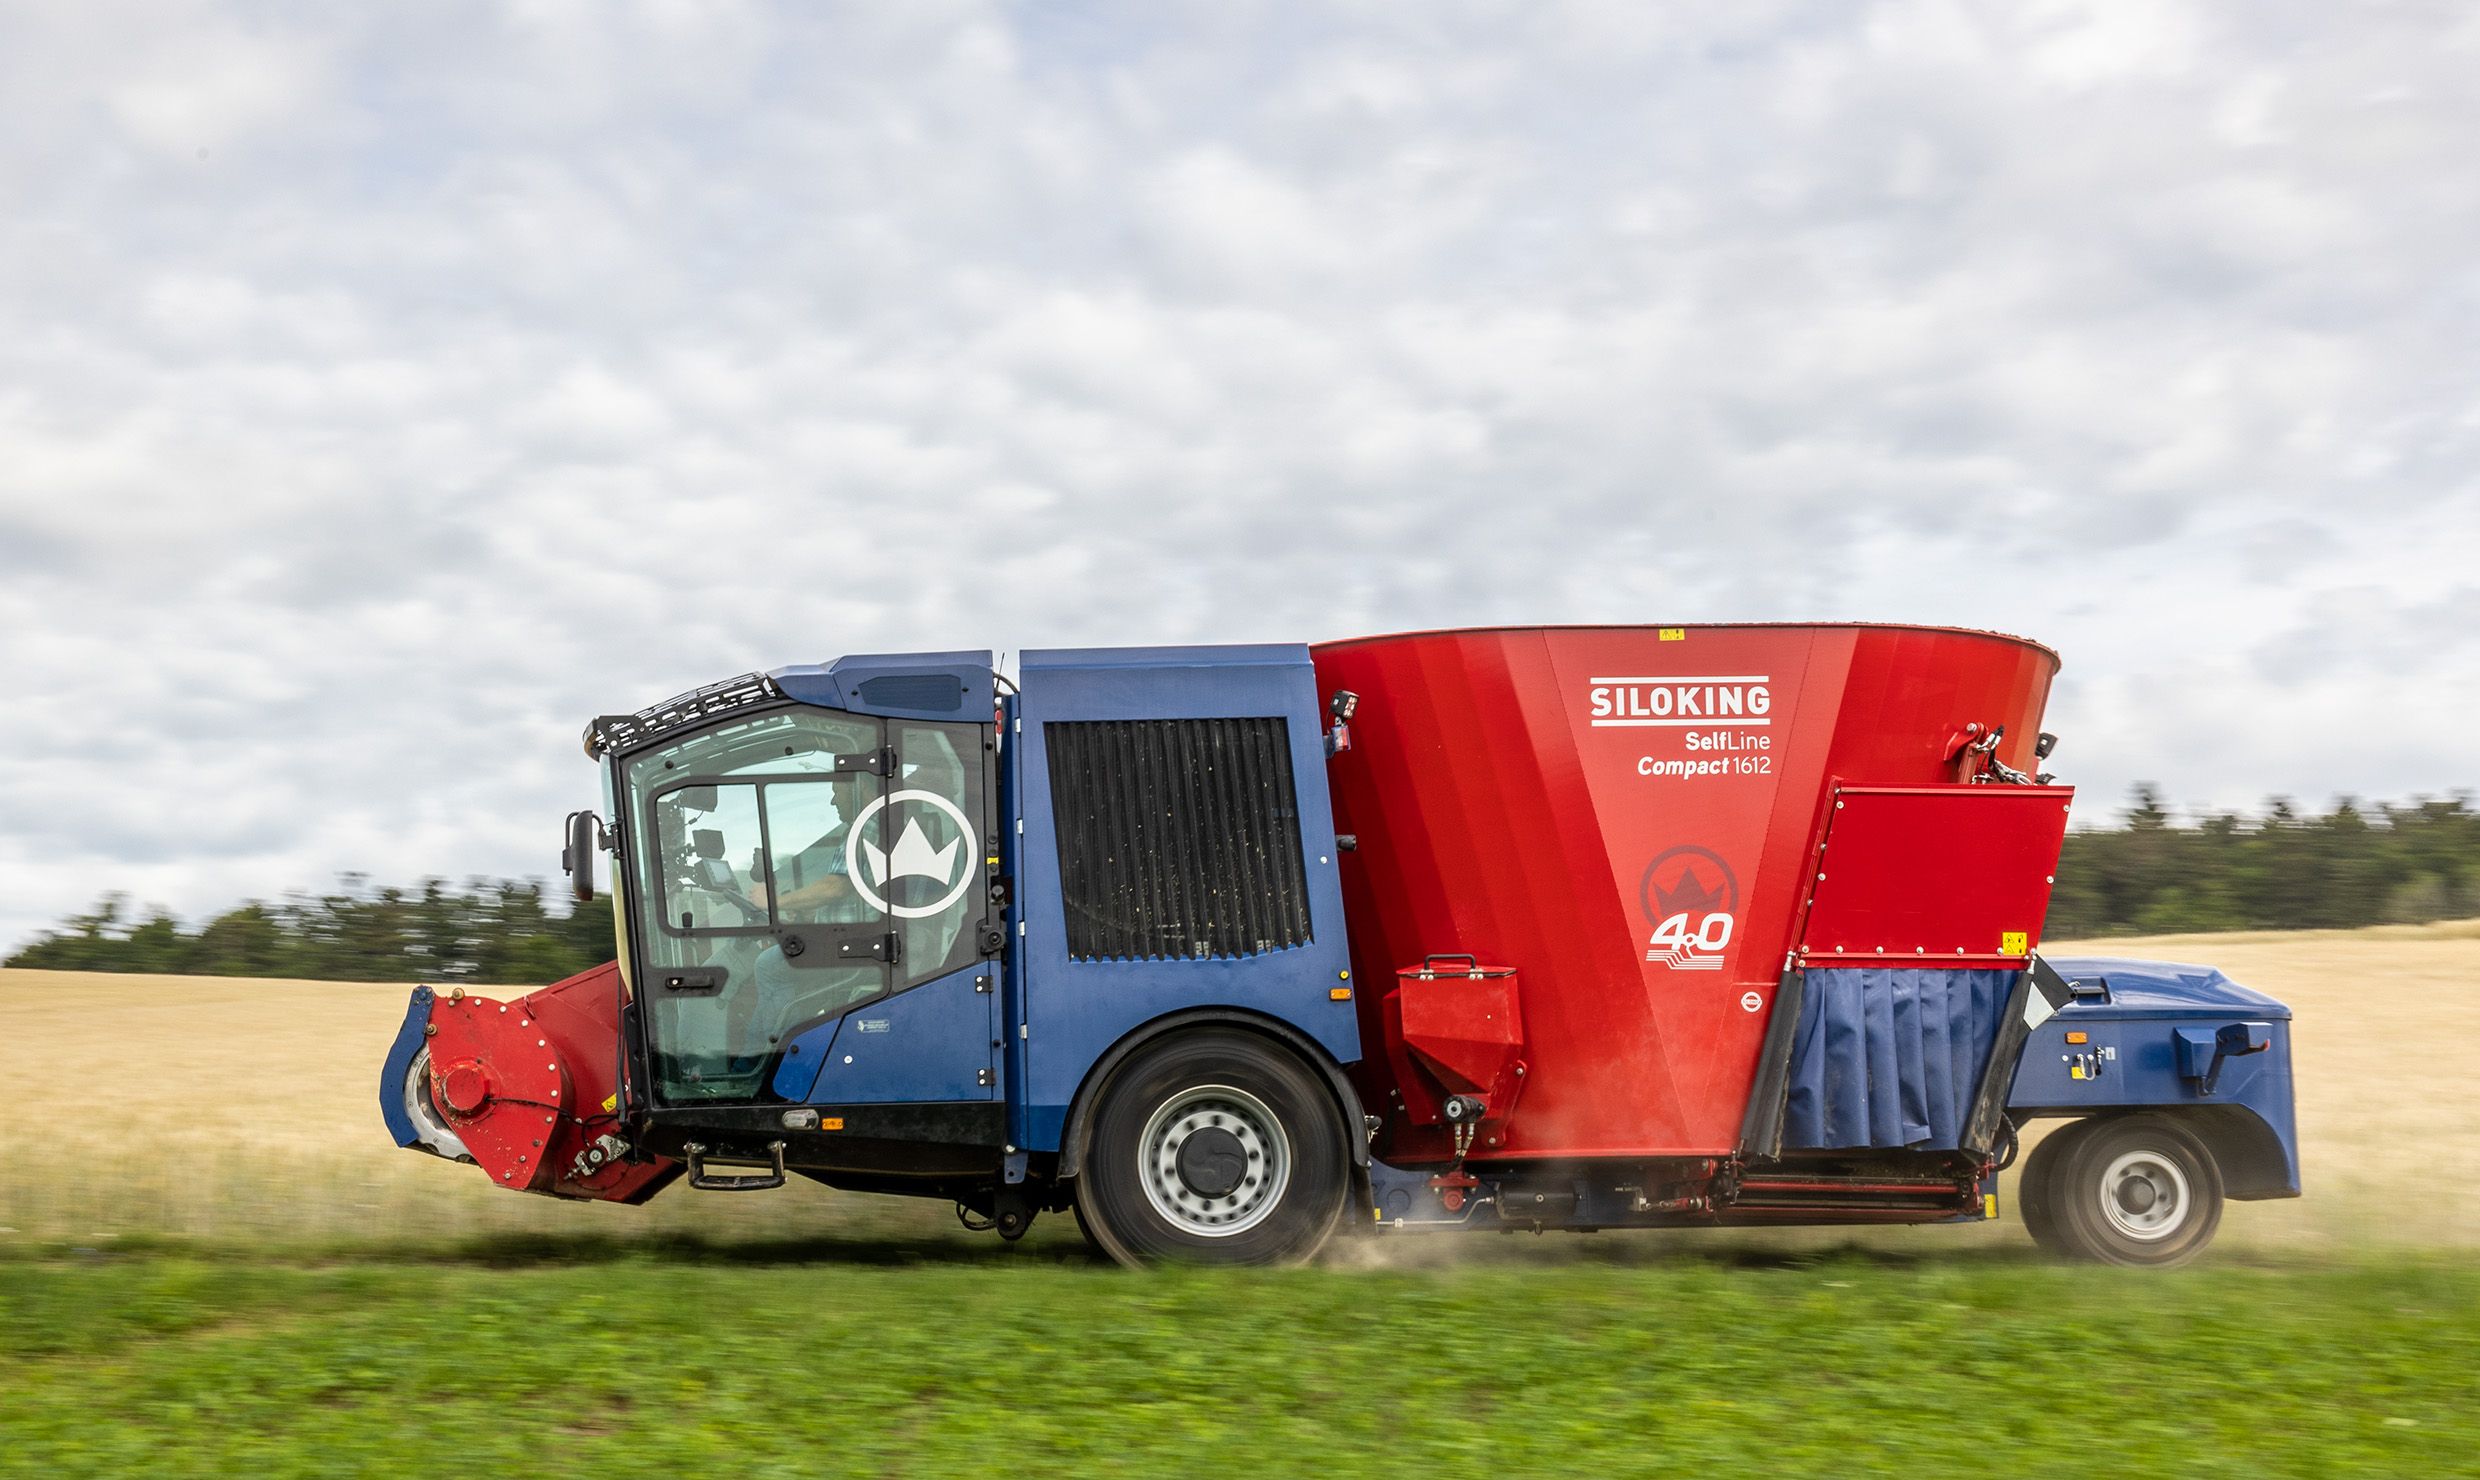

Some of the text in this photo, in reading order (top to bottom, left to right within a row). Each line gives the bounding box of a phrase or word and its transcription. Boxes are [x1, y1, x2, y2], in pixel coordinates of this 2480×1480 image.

[1590, 685, 1771, 717] SILOKING
[1685, 731, 1771, 751] SelfLine
[1637, 756, 1772, 780] Compact 1612
